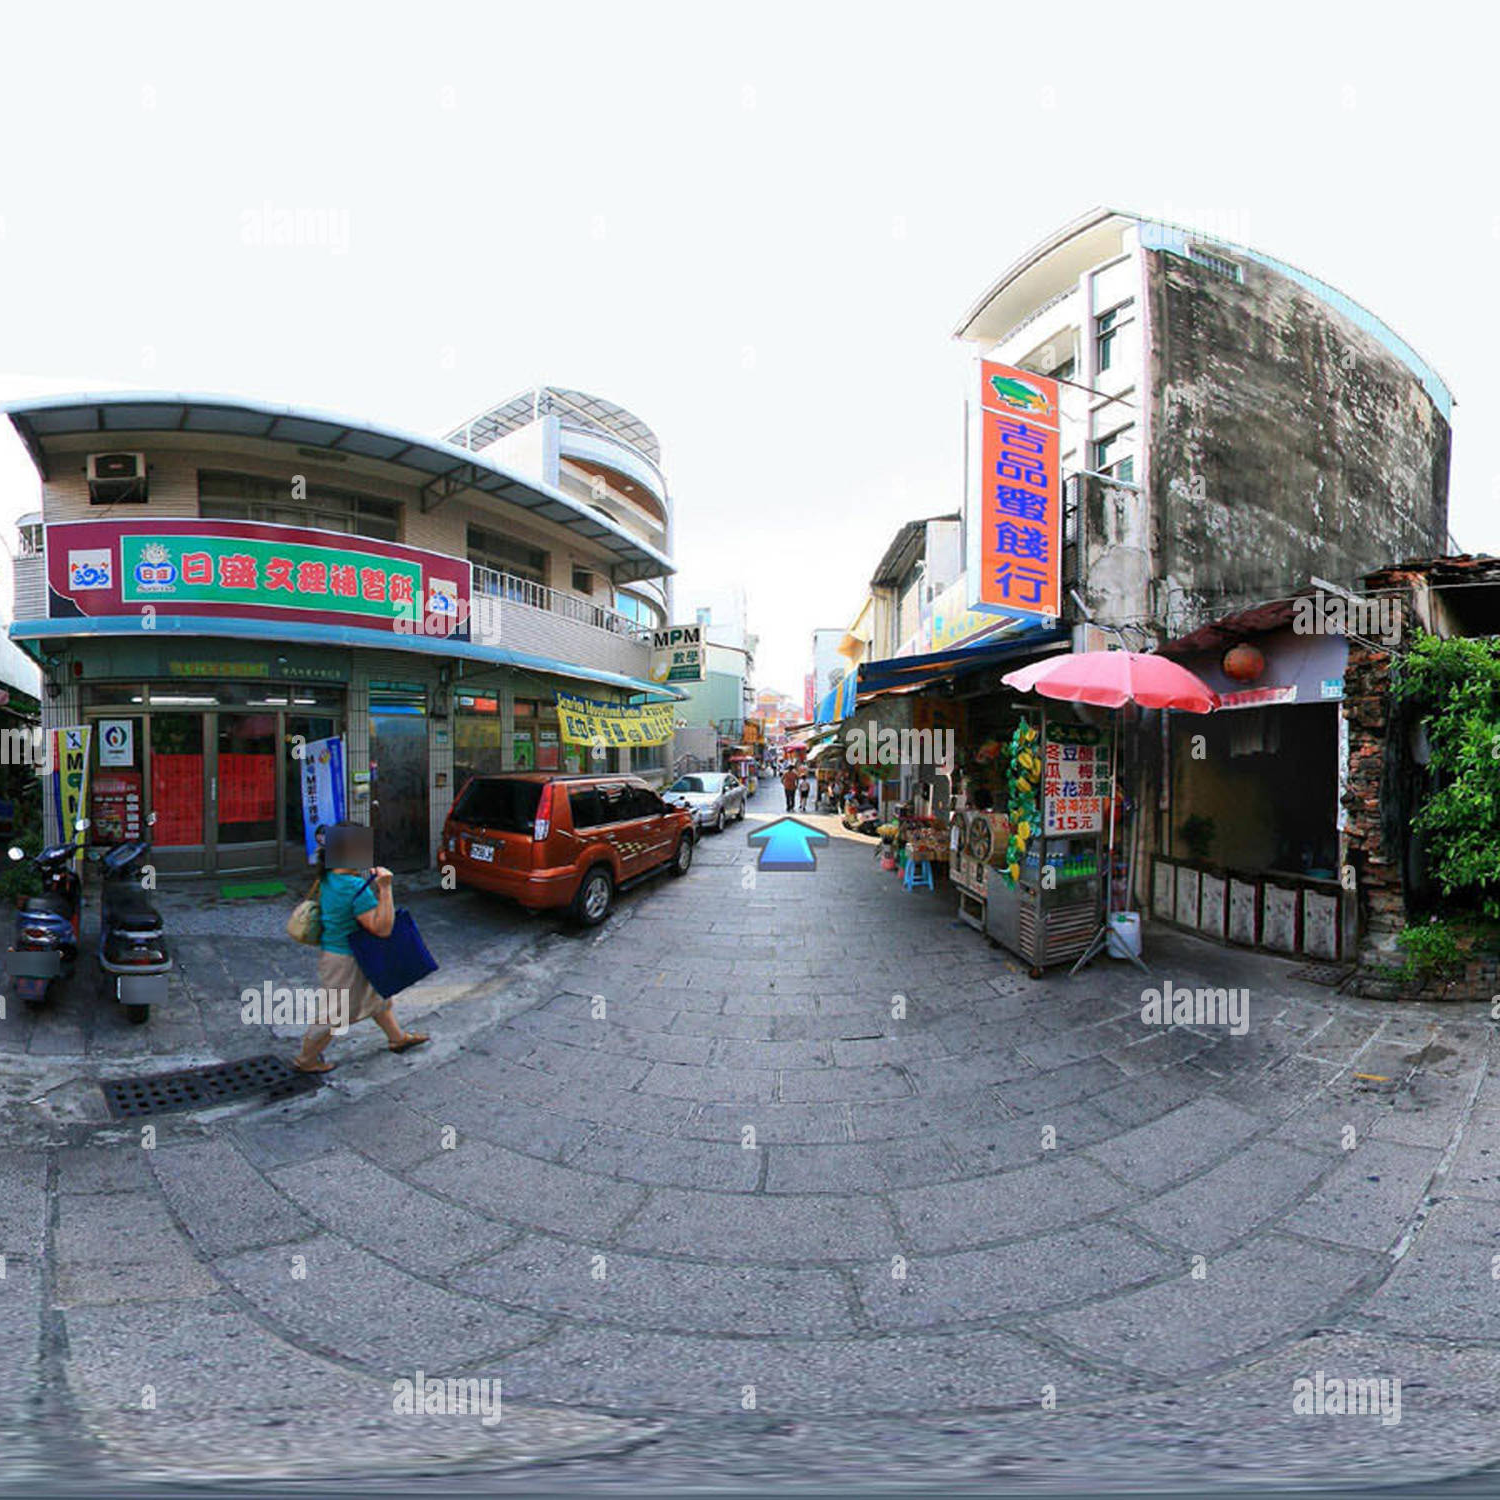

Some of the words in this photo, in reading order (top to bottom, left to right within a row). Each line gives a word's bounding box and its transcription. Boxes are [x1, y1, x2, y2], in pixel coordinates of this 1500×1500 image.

[994, 419, 1049, 604] 吉品蜜餞行
[181, 551, 415, 605] 日盛文理補習班
[654, 627, 701, 648] MPM
[1045, 744, 1061, 797] 冬瓜茶
[1056, 816, 1093, 831] 15元
